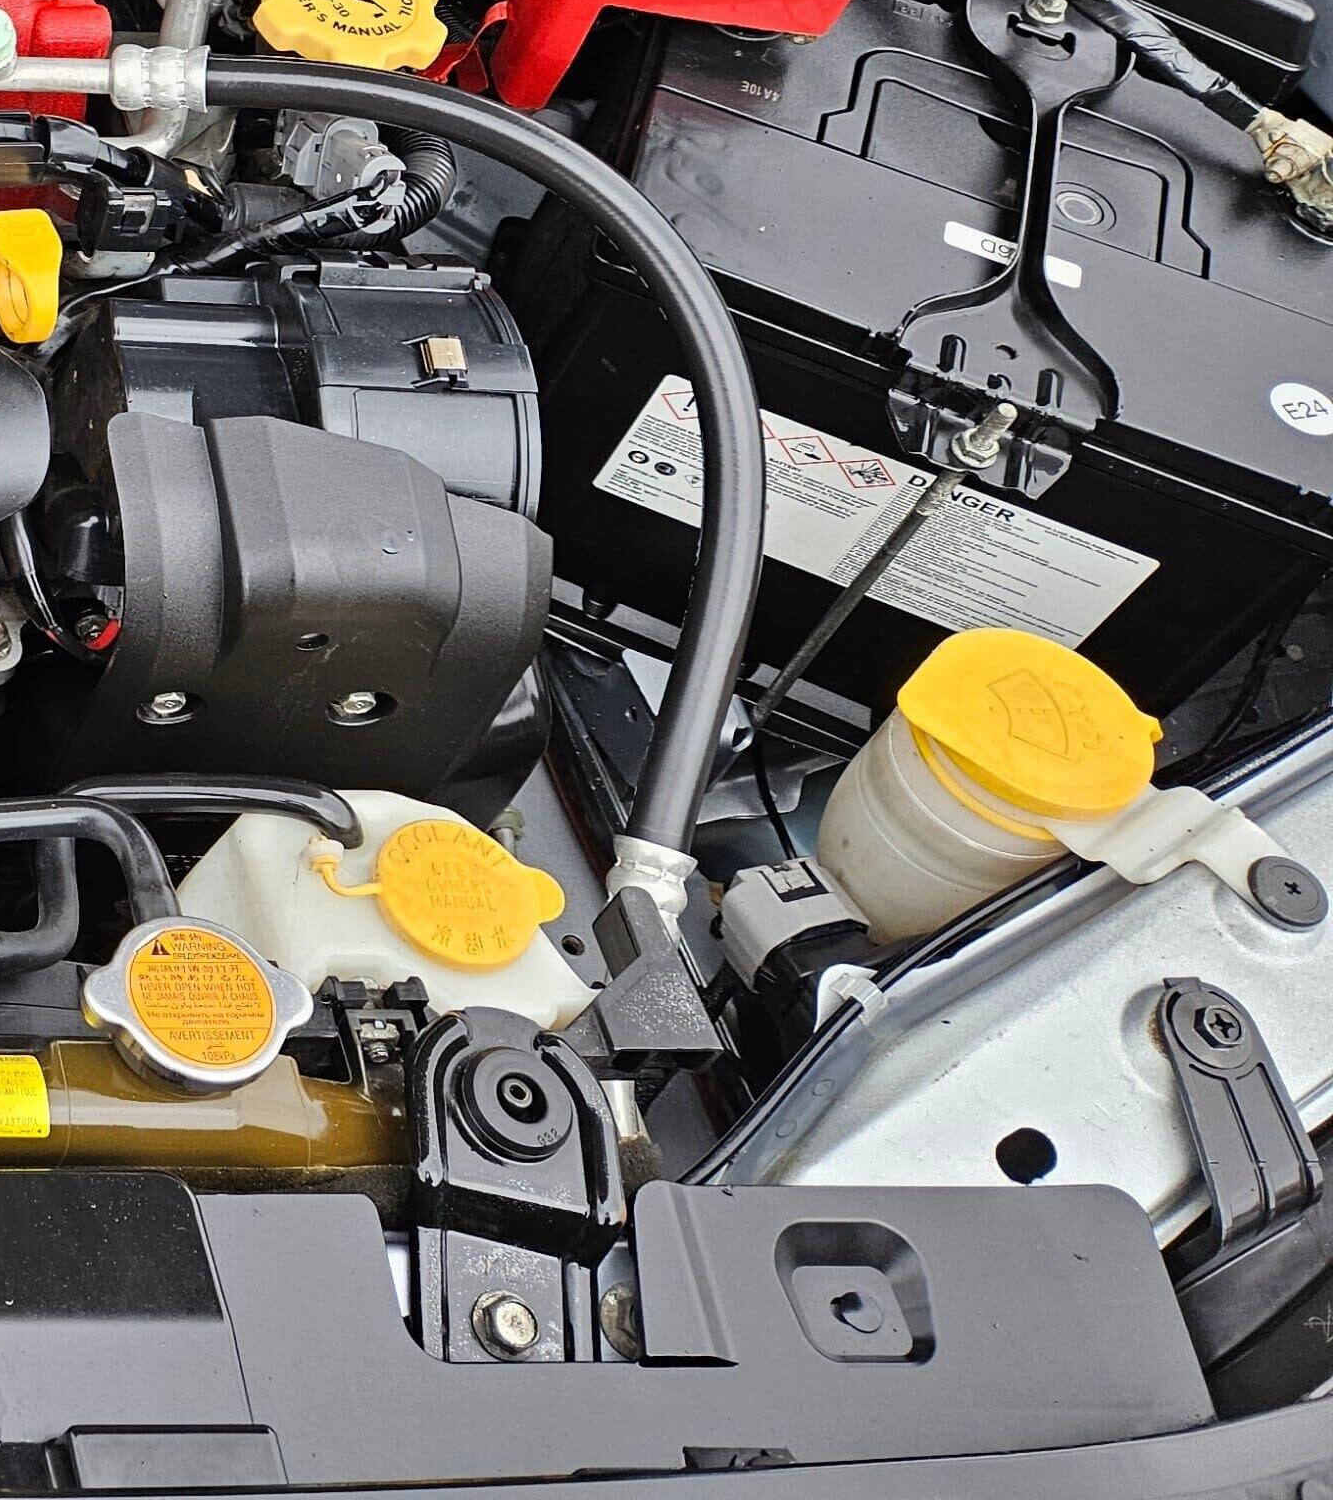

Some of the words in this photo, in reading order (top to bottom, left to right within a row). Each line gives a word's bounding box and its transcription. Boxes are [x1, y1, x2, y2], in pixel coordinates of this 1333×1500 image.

[333, 20, 402, 37] MANUAL
[739, 80, 781, 103] 4A10E
[1282, 399, 1329, 420] E24
[908, 473, 1016, 524] DNGER
[387, 824, 511, 867] COOLANT
[170, 942, 226, 951] WARNING
[140, 982, 171, 992] NEVER
[174, 983, 200, 992] OPEN
[204, 983, 233, 992] WHEN
[157, 991, 186, 1001] JAMAIS
[169, 1030, 255, 1040] AVERTISSEMENT
